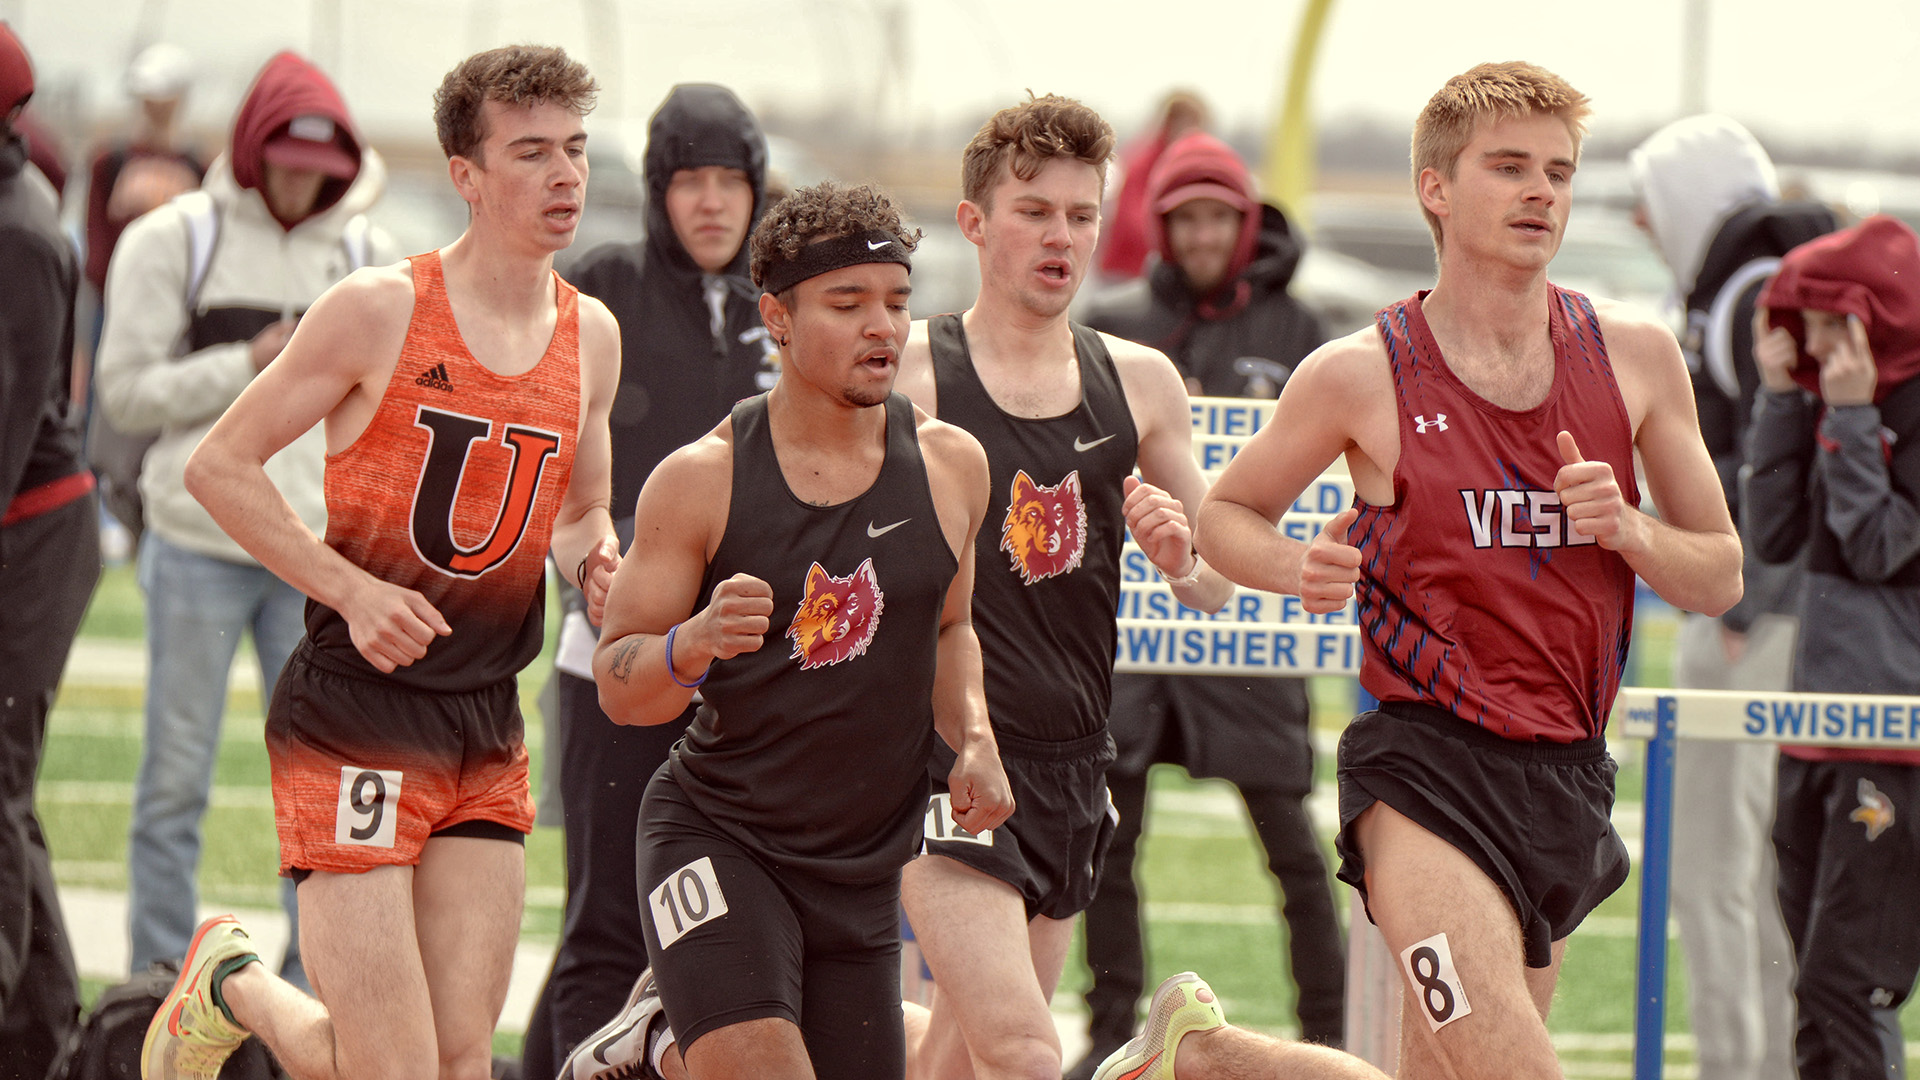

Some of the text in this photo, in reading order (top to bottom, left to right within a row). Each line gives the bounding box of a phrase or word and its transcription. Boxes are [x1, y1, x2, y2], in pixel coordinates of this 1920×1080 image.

[415, 377, 454, 392] adidas
[409, 404, 561, 580] U
[1315, 632, 1363, 669] FI
[350, 771, 386, 840] 9
[660, 868, 709, 934] 10
[1410, 946, 1455, 1023] 8
